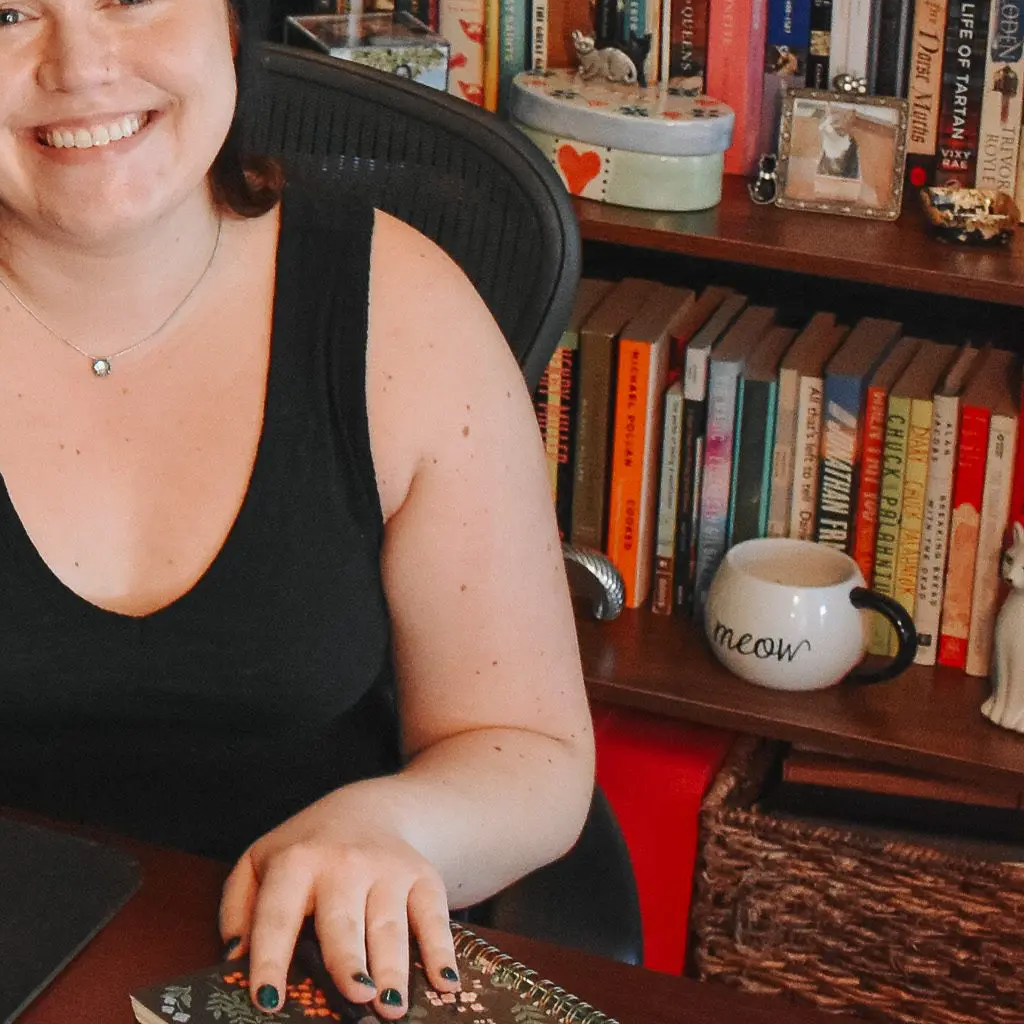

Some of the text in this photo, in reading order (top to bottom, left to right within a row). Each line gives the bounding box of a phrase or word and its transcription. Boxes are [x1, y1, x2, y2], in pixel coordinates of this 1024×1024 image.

[537, 6, 545, 23] THE
[629, 1, 639, 32] KNOW
[959, 2, 976, 39] LIFE
[536, 26, 544, 52] GREAT
[680, 6, 695, 71] QUEENS
[957, 44, 972, 68] OF
[911, 90, 933, 143] Myths
[951, 74, 971, 141] TARTAN
[941, 149, 971, 160] VIXY
[942, 159, 968, 169] RAE
[982, 133, 1000, 183] ROYLE
[999, 124, 1016, 196] TREVOR
[810, 387, 821, 404] All
[807, 407, 819, 439] that's
[930, 412, 941, 464] JACOBS
[944, 423, 953, 456] ALAN
[623, 351, 640, 551] MICHAEL POLLAN COOKED
[805, 443, 817, 462] left
[802, 464, 813, 479] to
[873, 415, 905, 595] CHUCK PALAHNIU
[904, 480, 924, 521] CHUCK
[919, 499, 934, 601] WITH THE DEAD
[929, 495, 946, 607] BREAKING BREAD
[713, 622, 810, 662] meow
